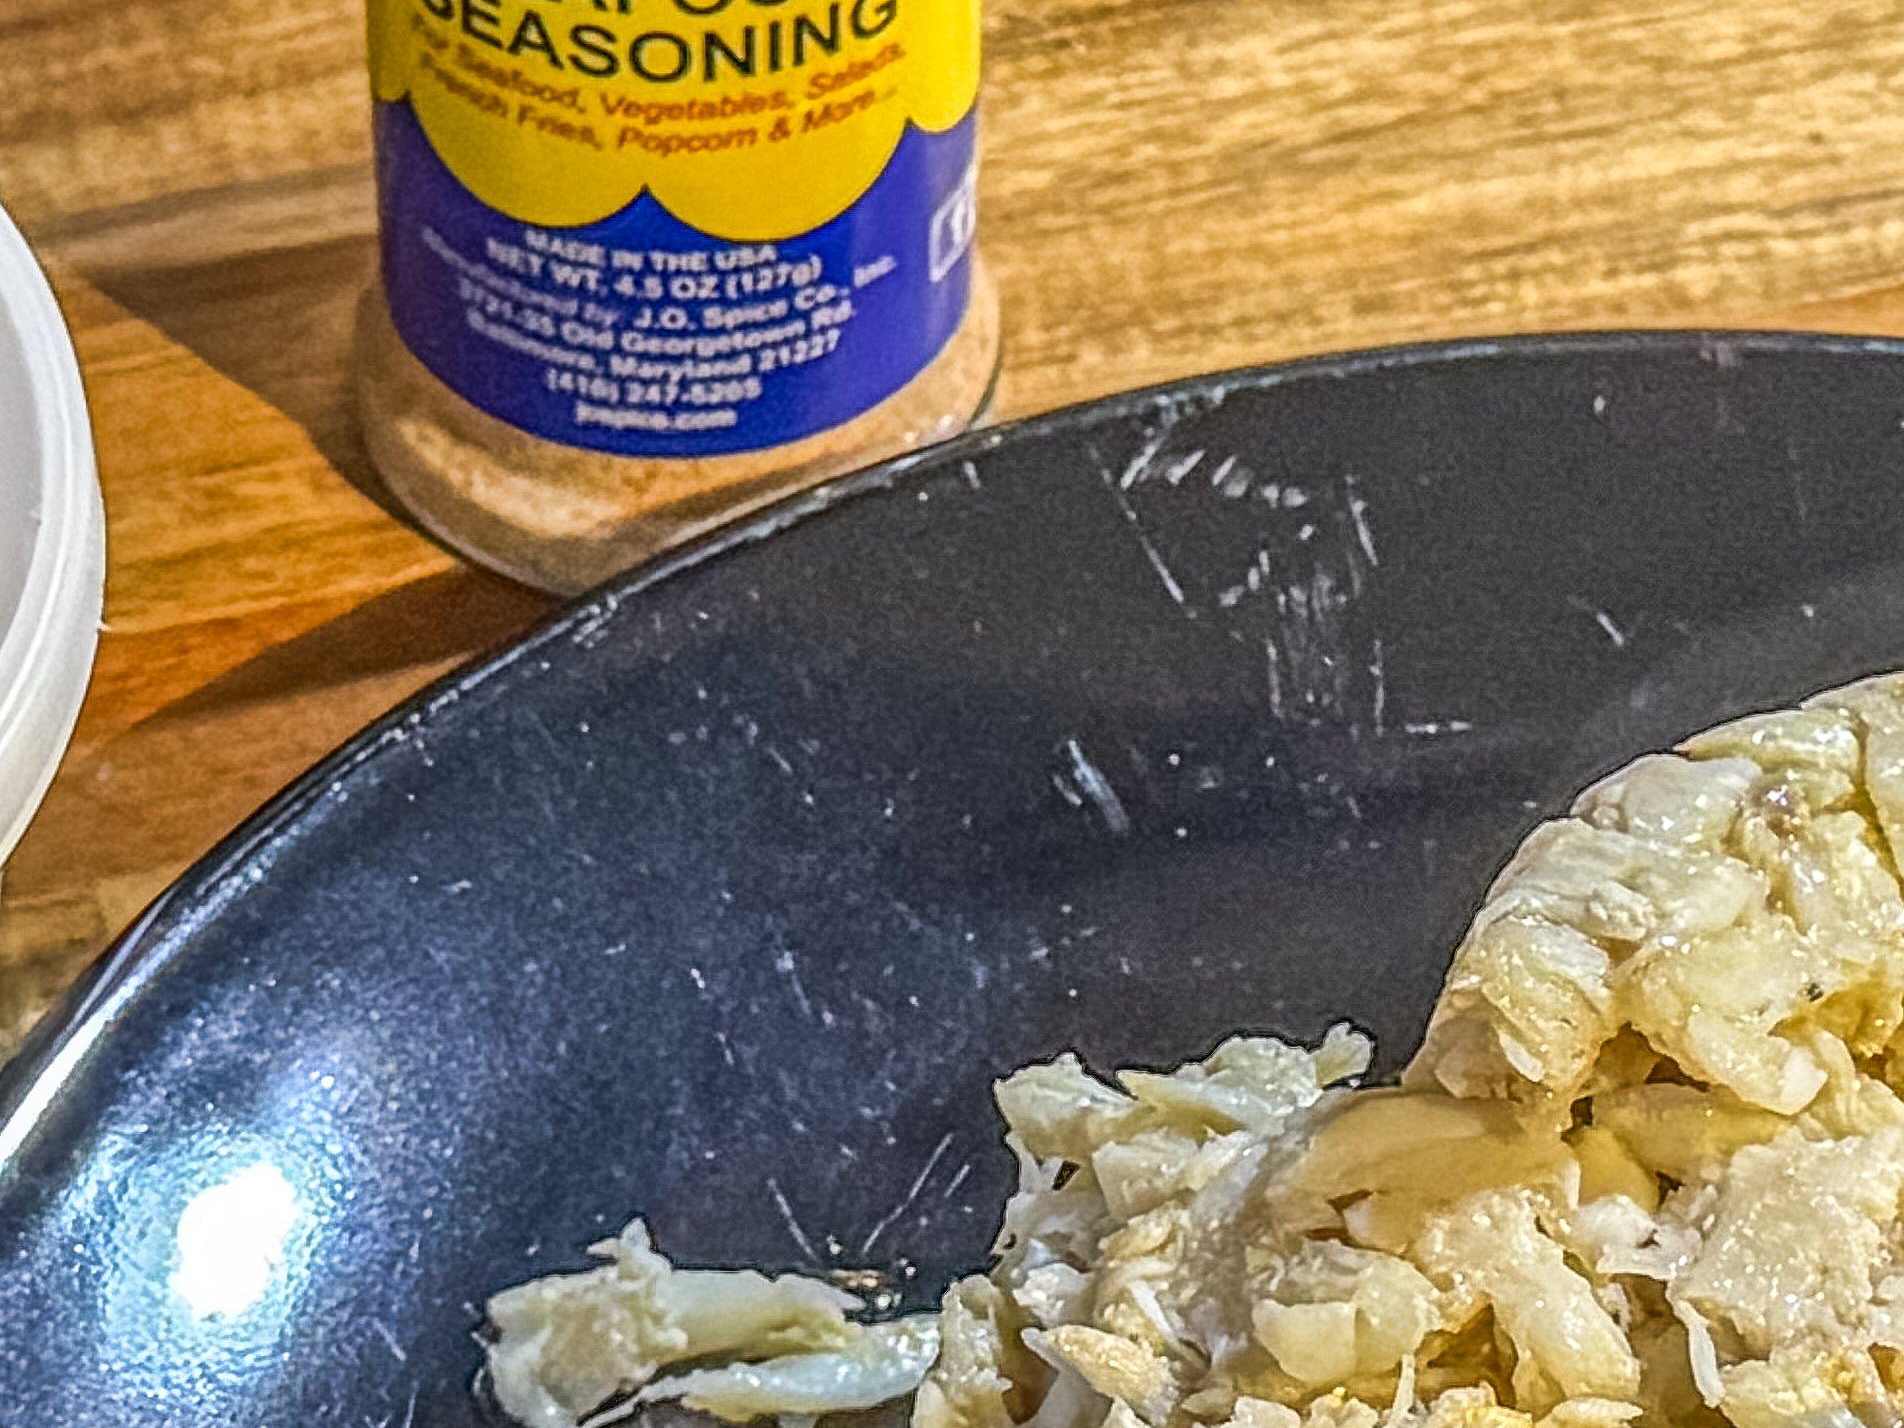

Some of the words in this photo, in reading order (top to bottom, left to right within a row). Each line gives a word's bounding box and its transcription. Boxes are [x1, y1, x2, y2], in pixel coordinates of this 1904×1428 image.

[616, 126, 758, 158] Popcorn
[768, 117, 791, 142] &
[526, 229, 605, 266] MADE
[612, 249, 645, 272] IN
[649, 250, 708, 272] THE
[714, 244, 778, 270] USA
[670, 275, 719, 300] OZ
[633, 306, 696, 331] J.O.
[703, 300, 790, 330] Spice
[610, 353, 753, 382] Maryland
